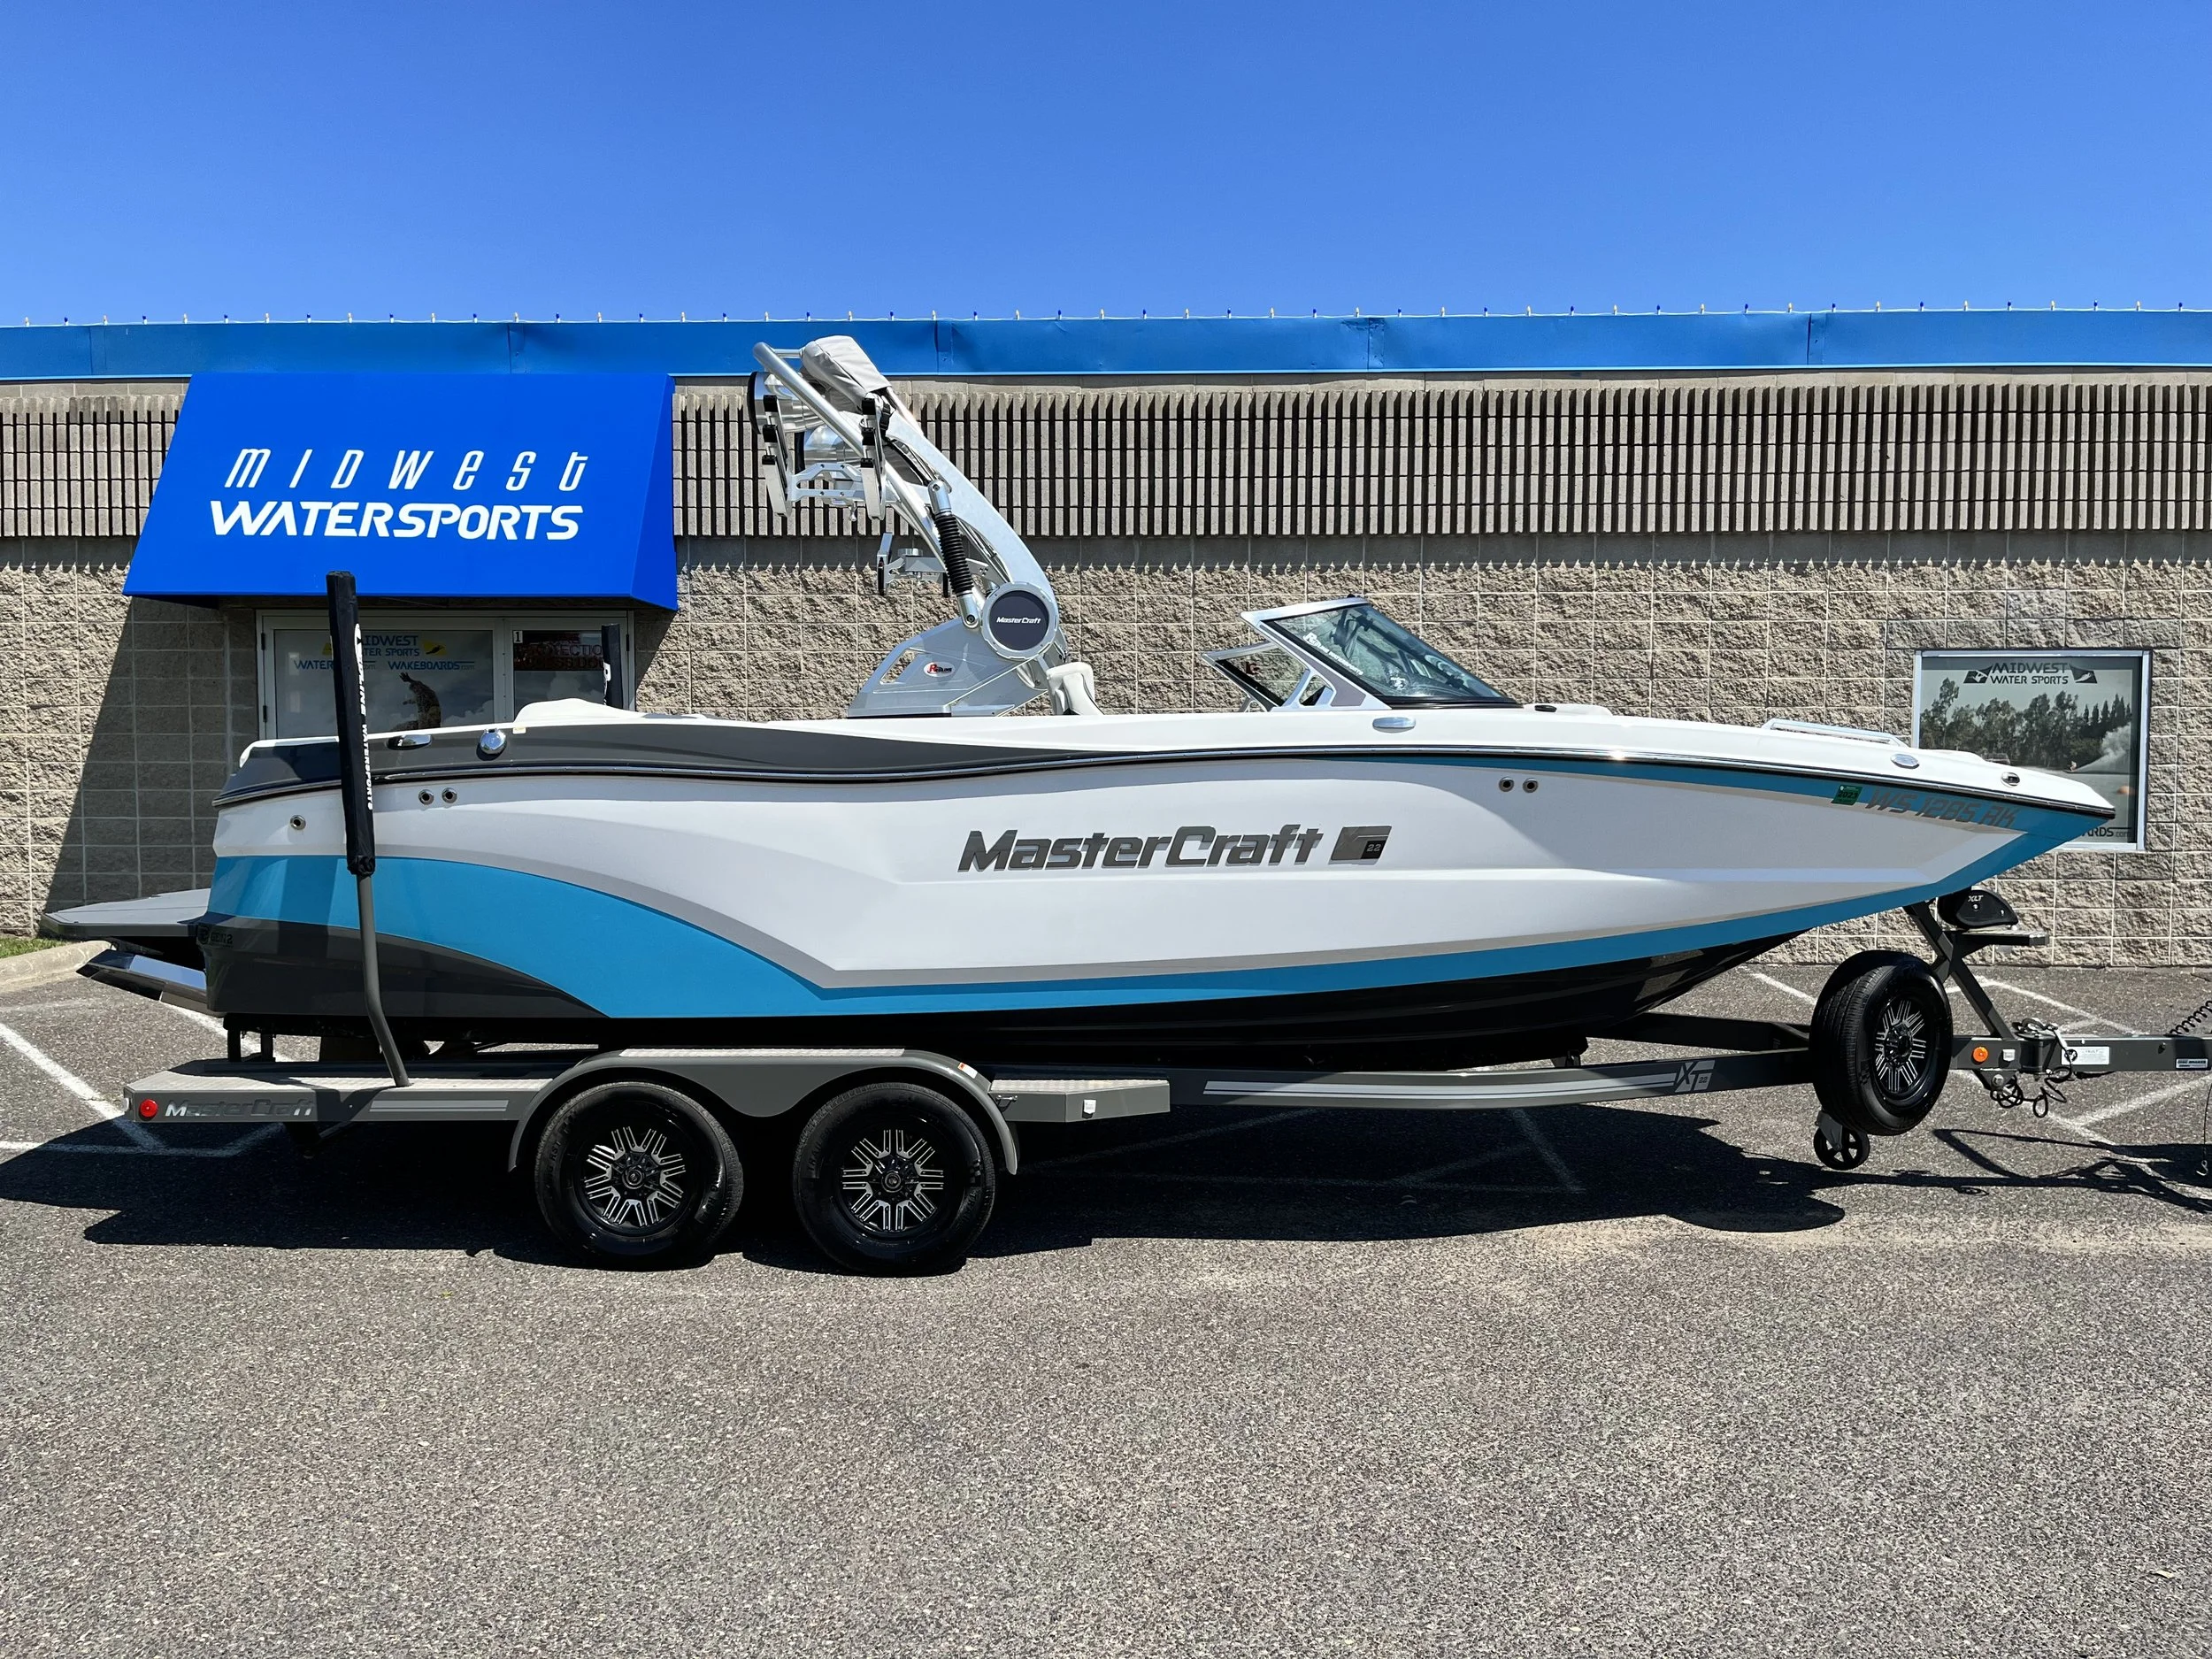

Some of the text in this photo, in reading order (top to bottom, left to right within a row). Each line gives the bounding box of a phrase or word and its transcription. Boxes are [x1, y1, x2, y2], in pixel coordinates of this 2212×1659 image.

[209, 500, 584, 541] WATERSPORTS
[385, 647, 420, 657] SPORTS
[1991, 663, 2069, 673] MIDWEST
[1990, 675, 2069, 685] WATER SPORTS
[1865, 787, 1917, 813] WS
[957, 824, 1325, 872] MasterCraft
[1366, 843, 1382, 852] 22
[165, 1098, 315, 1117] MasterCraft
